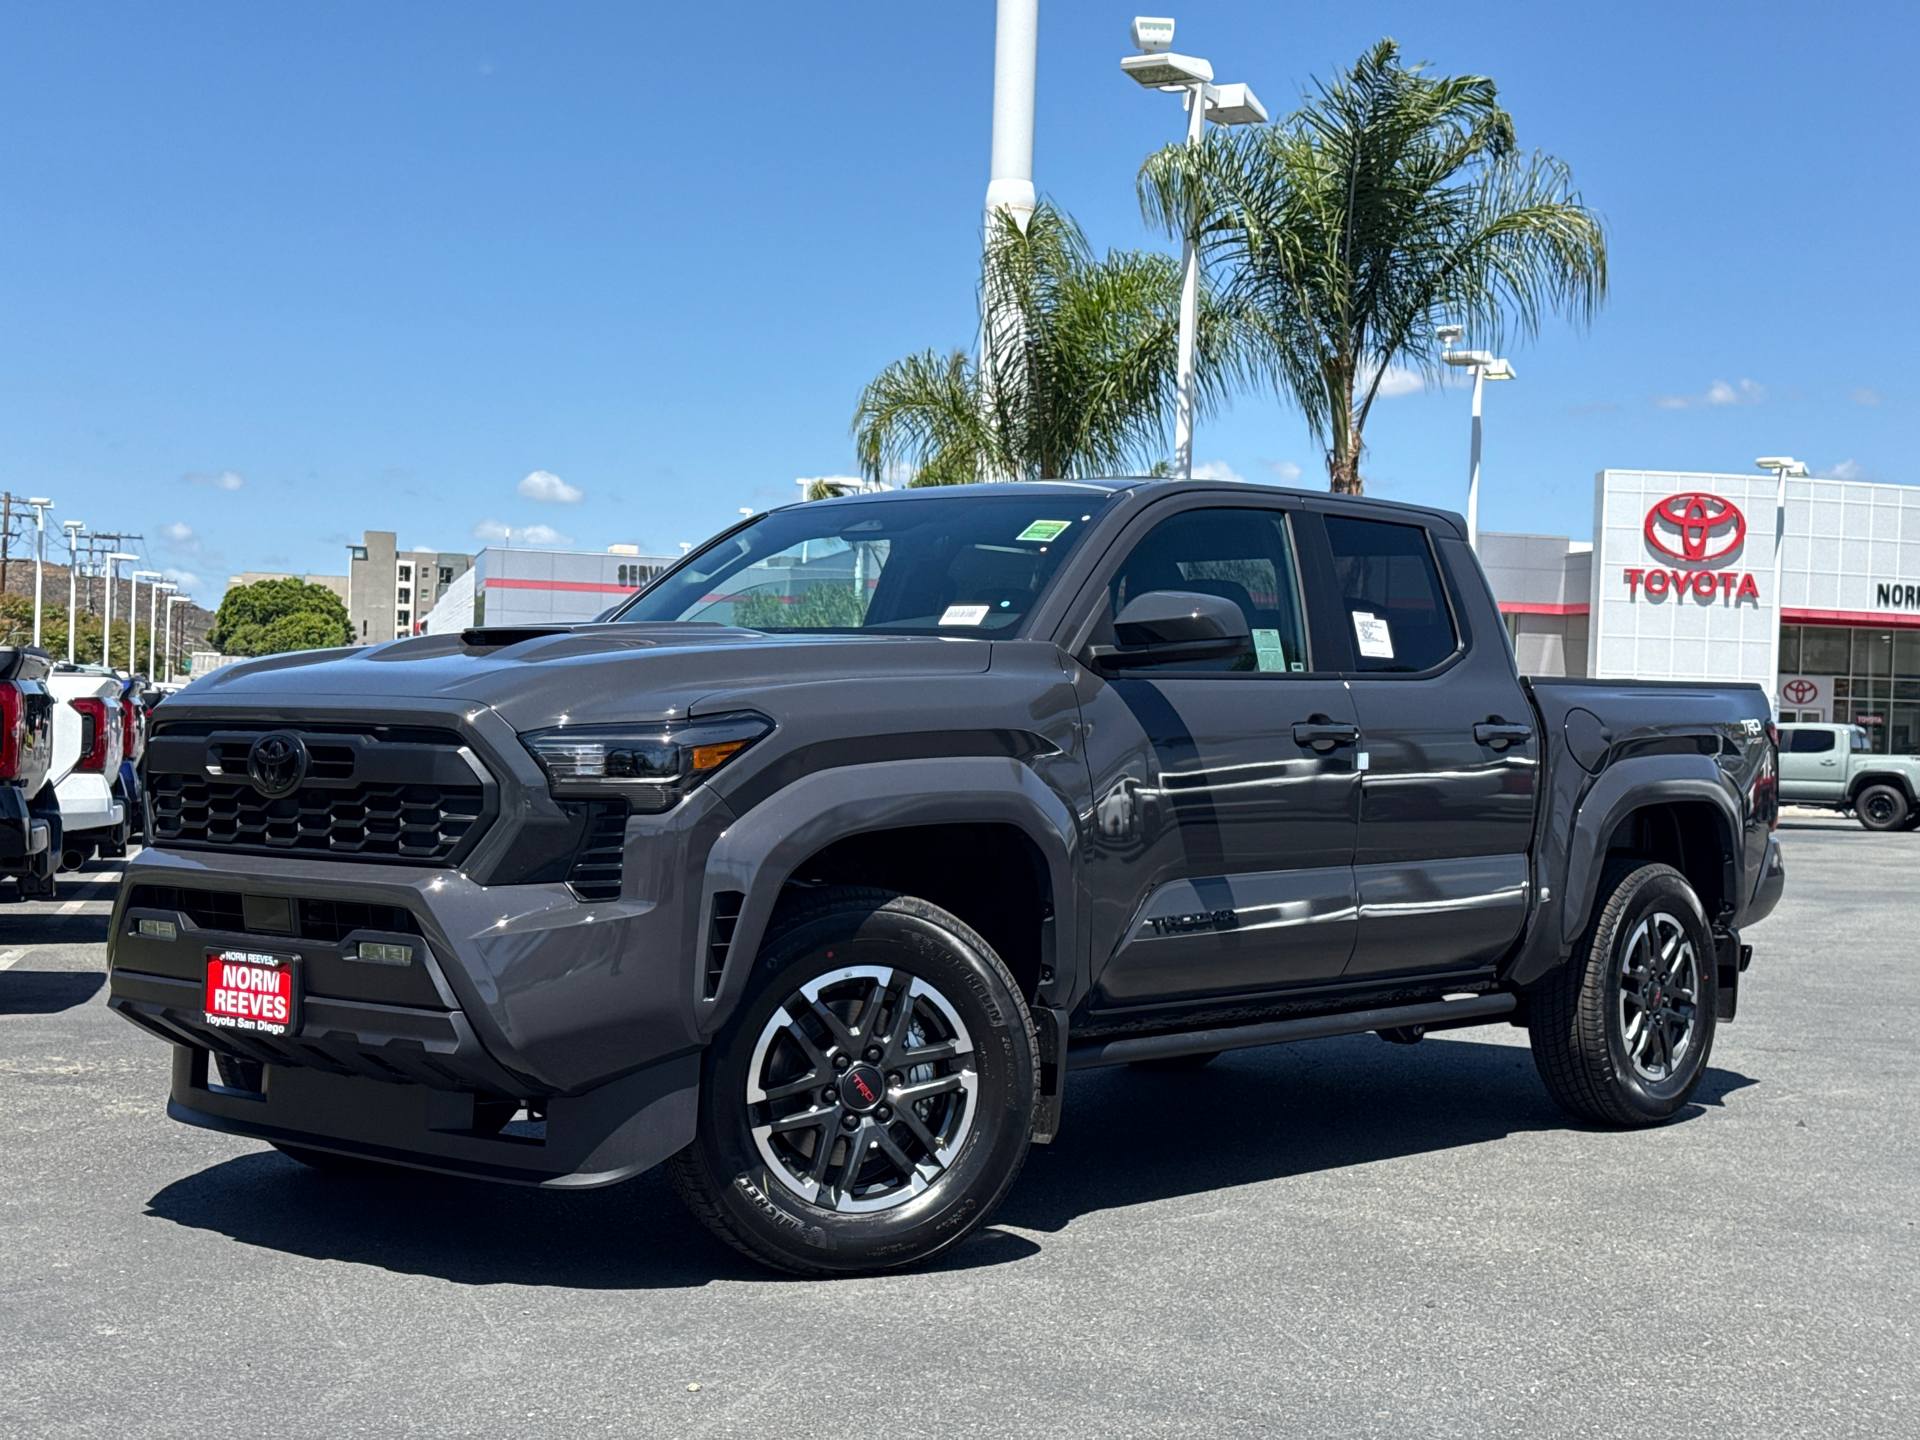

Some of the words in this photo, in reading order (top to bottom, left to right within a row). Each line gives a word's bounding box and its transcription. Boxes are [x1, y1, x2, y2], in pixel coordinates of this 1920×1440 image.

[1623, 568, 1760, 600] TOYOTA
[1876, 583, 1920, 609] NOR
[1740, 718, 1762, 736] TRD
[226, 951, 247, 962] NORM
[247, 953, 274, 966] REEVES
[223, 965, 280, 993] NORM
[938, 950, 1004, 1024] MICHELIN
[214, 989, 286, 1019] REEVES
[205, 1013, 236, 1027] Toyota
[237, 1017, 255, 1030] San
[257, 1020, 285, 1035] Diego
[853, 1073, 875, 1102] TRD
